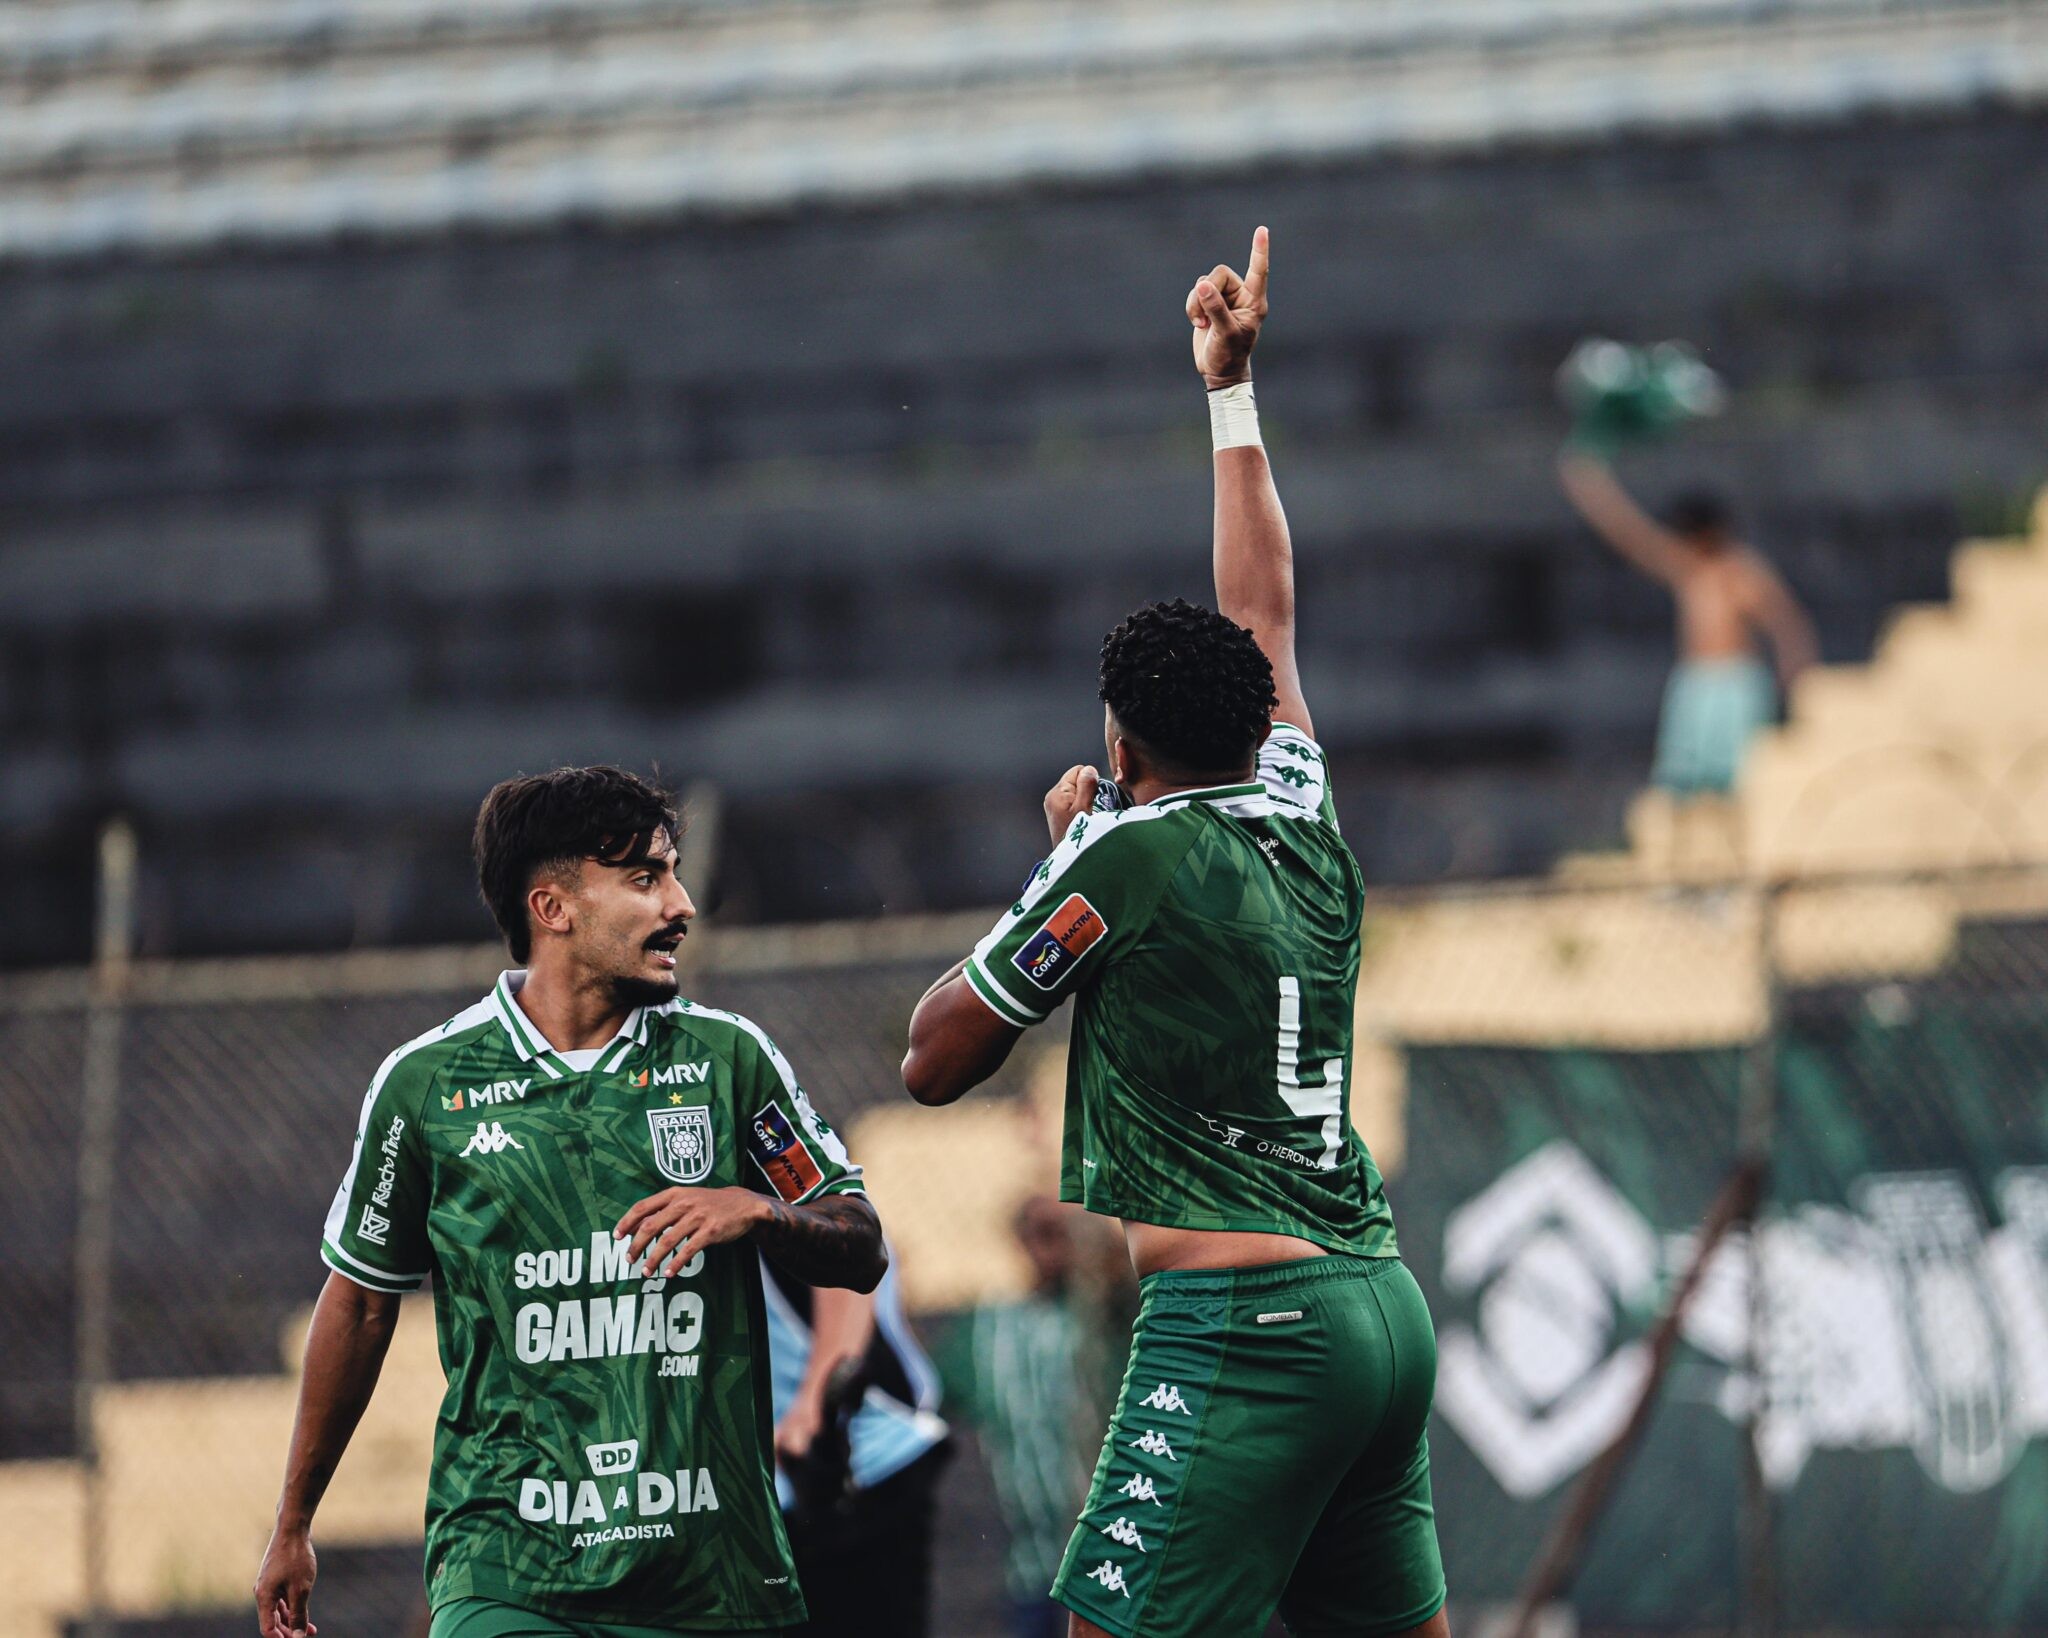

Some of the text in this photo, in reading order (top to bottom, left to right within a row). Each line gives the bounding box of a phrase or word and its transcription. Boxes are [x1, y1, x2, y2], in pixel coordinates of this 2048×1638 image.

[1061, 910, 1094, 944] MACTRA
[1032, 946, 1060, 978] Coral
[653, 1061, 711, 1086] MRV
[1277, 976, 1343, 1169] 4
[468, 1078, 532, 1108] MRV
[657, 1115, 703, 1127] GAMA
[753, 1120, 777, 1151] Coral
[780, 1154, 806, 1194] MACTRA
[514, 1248, 583, 1290] SOU
[515, 1278, 704, 1364] GAMÃO
[1260, 1312, 1299, 1321] KOMBAT
[657, 1355, 700, 1377] .COM
[518, 1467, 719, 1525] DIA A DIA
[571, 1523, 675, 1547] ATACADISTA
